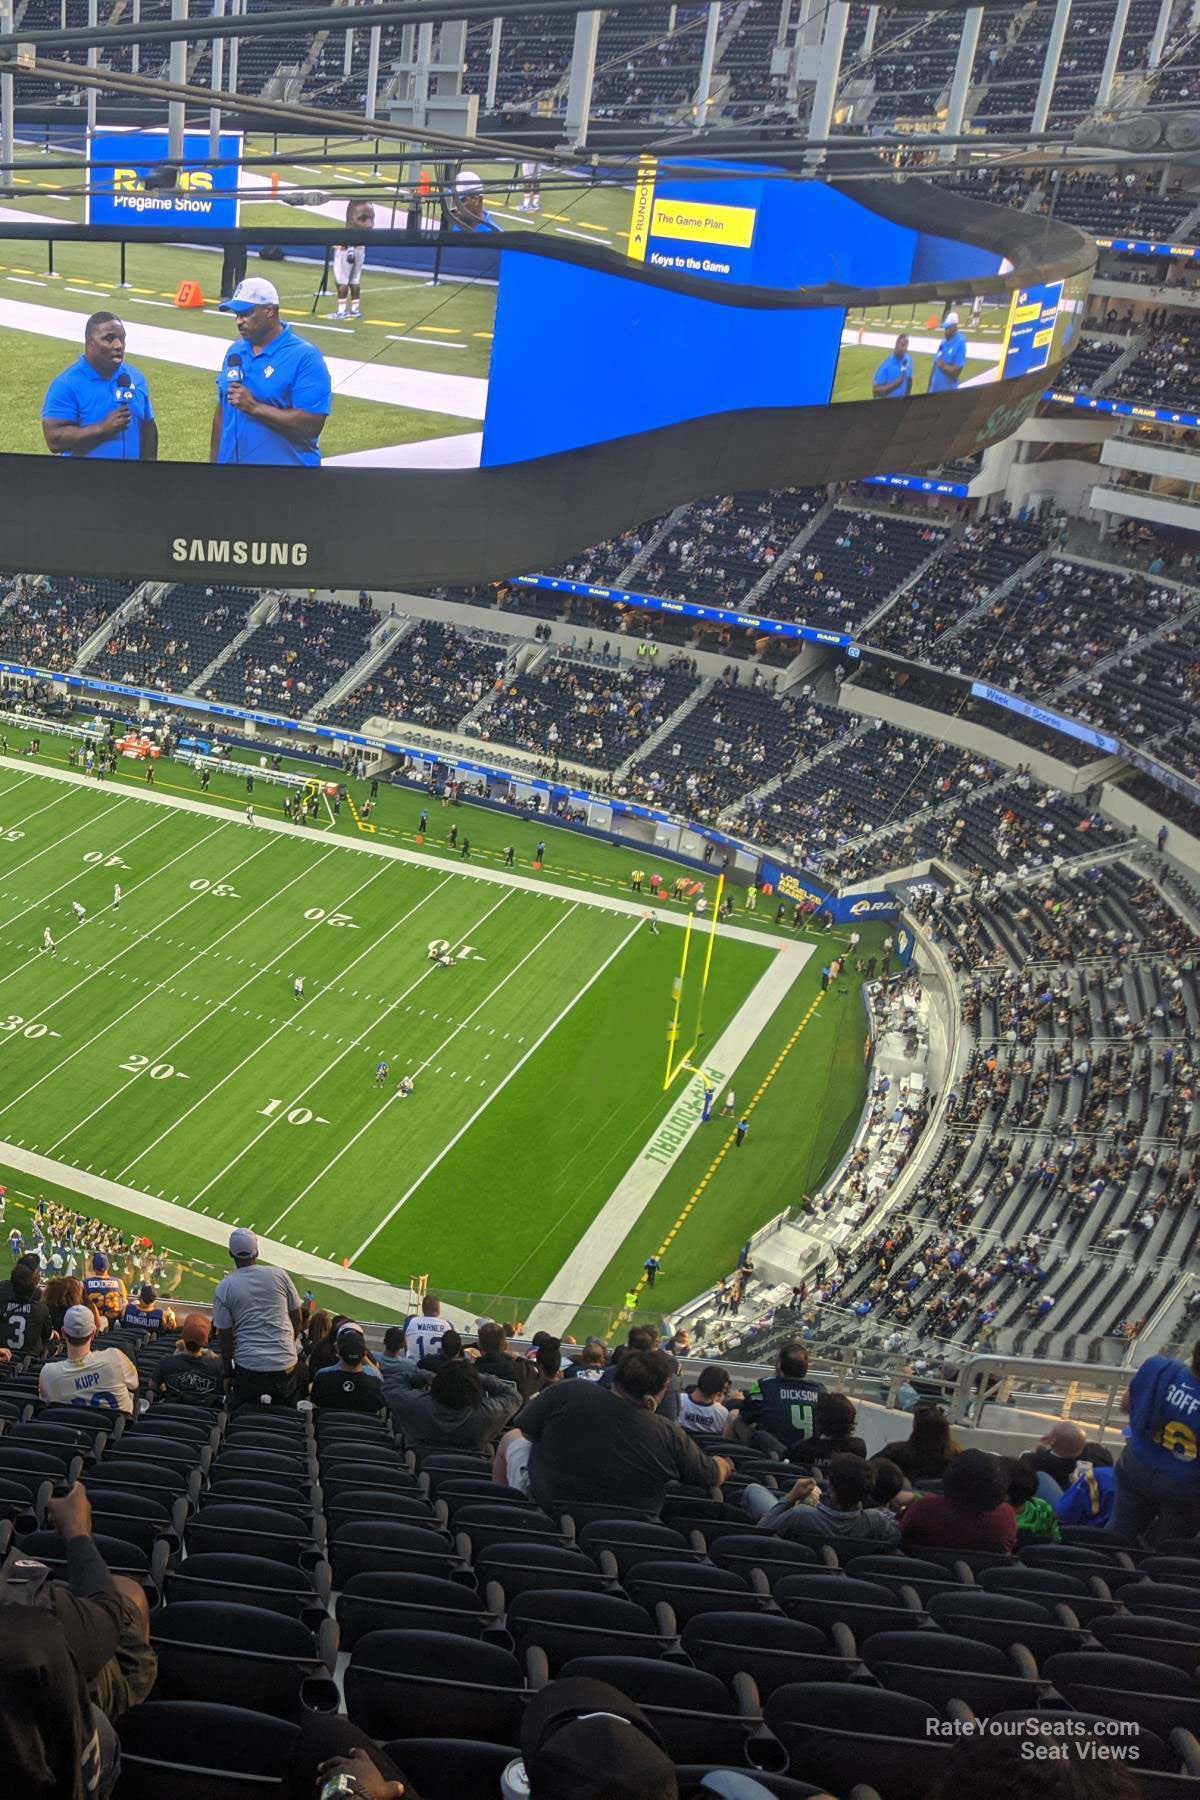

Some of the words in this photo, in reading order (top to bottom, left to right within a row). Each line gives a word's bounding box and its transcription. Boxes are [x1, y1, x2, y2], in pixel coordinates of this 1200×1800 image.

[114, 195, 171, 212] Pregame
[175, 198, 212, 213] Show
[657, 213, 673, 223] The
[676, 215, 702, 227] Game
[704, 219, 724, 229] Plan
[651, 253, 674, 267] Keys
[675, 256, 685, 267] to
[686, 257, 701, 269] the
[702, 260, 730, 273] Game
[172, 538, 308, 566] SAMSUNG
[986, 689, 1009, 705] Week
[780, 872, 799, 886] LOS
[118, 1054, 175, 1080] 20
[256, 1098, 314, 1125] 10
[7, 1315, 27, 1349] 3
[74, 1372, 100, 1391] KUPP
[780, 1389, 818, 1402] DICKSON
[791, 1404, 813, 1440] 4
